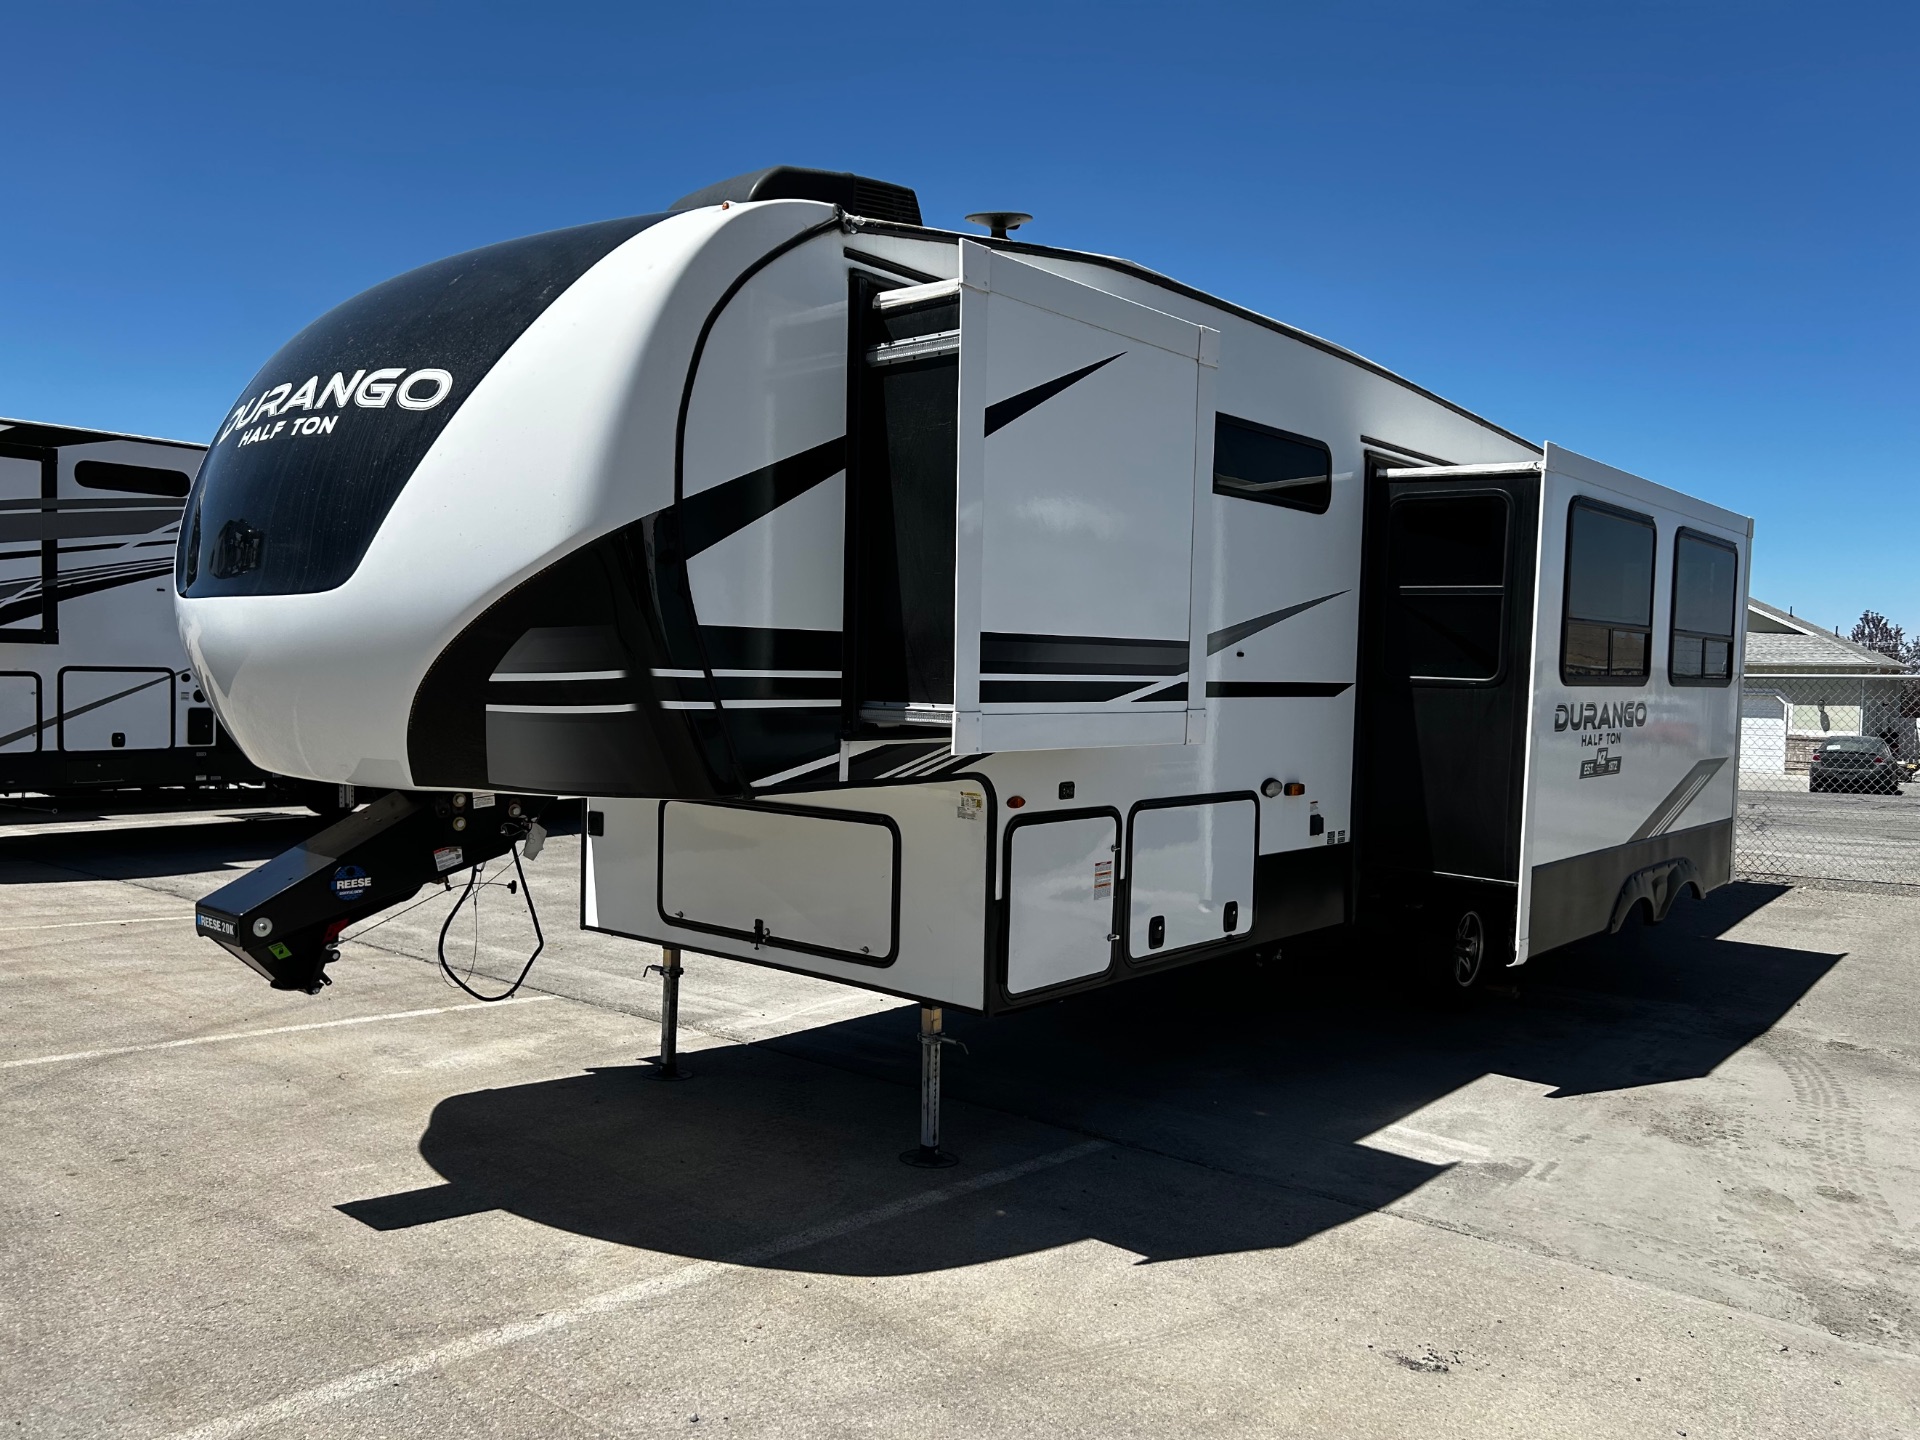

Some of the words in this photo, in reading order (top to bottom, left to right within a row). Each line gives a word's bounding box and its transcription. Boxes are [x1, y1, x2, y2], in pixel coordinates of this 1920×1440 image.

[217, 368, 453, 447] DURANGO
[238, 420, 287, 448] HALF
[290, 415, 339, 436] TON
[1554, 701, 1647, 732] DURANGO
[1581, 733, 1603, 747] HALF
[1606, 732, 1622, 745] TON
[336, 877, 372, 890] REESE
[201, 915, 222, 932] REESE
[221, 922, 235, 936] 20K
